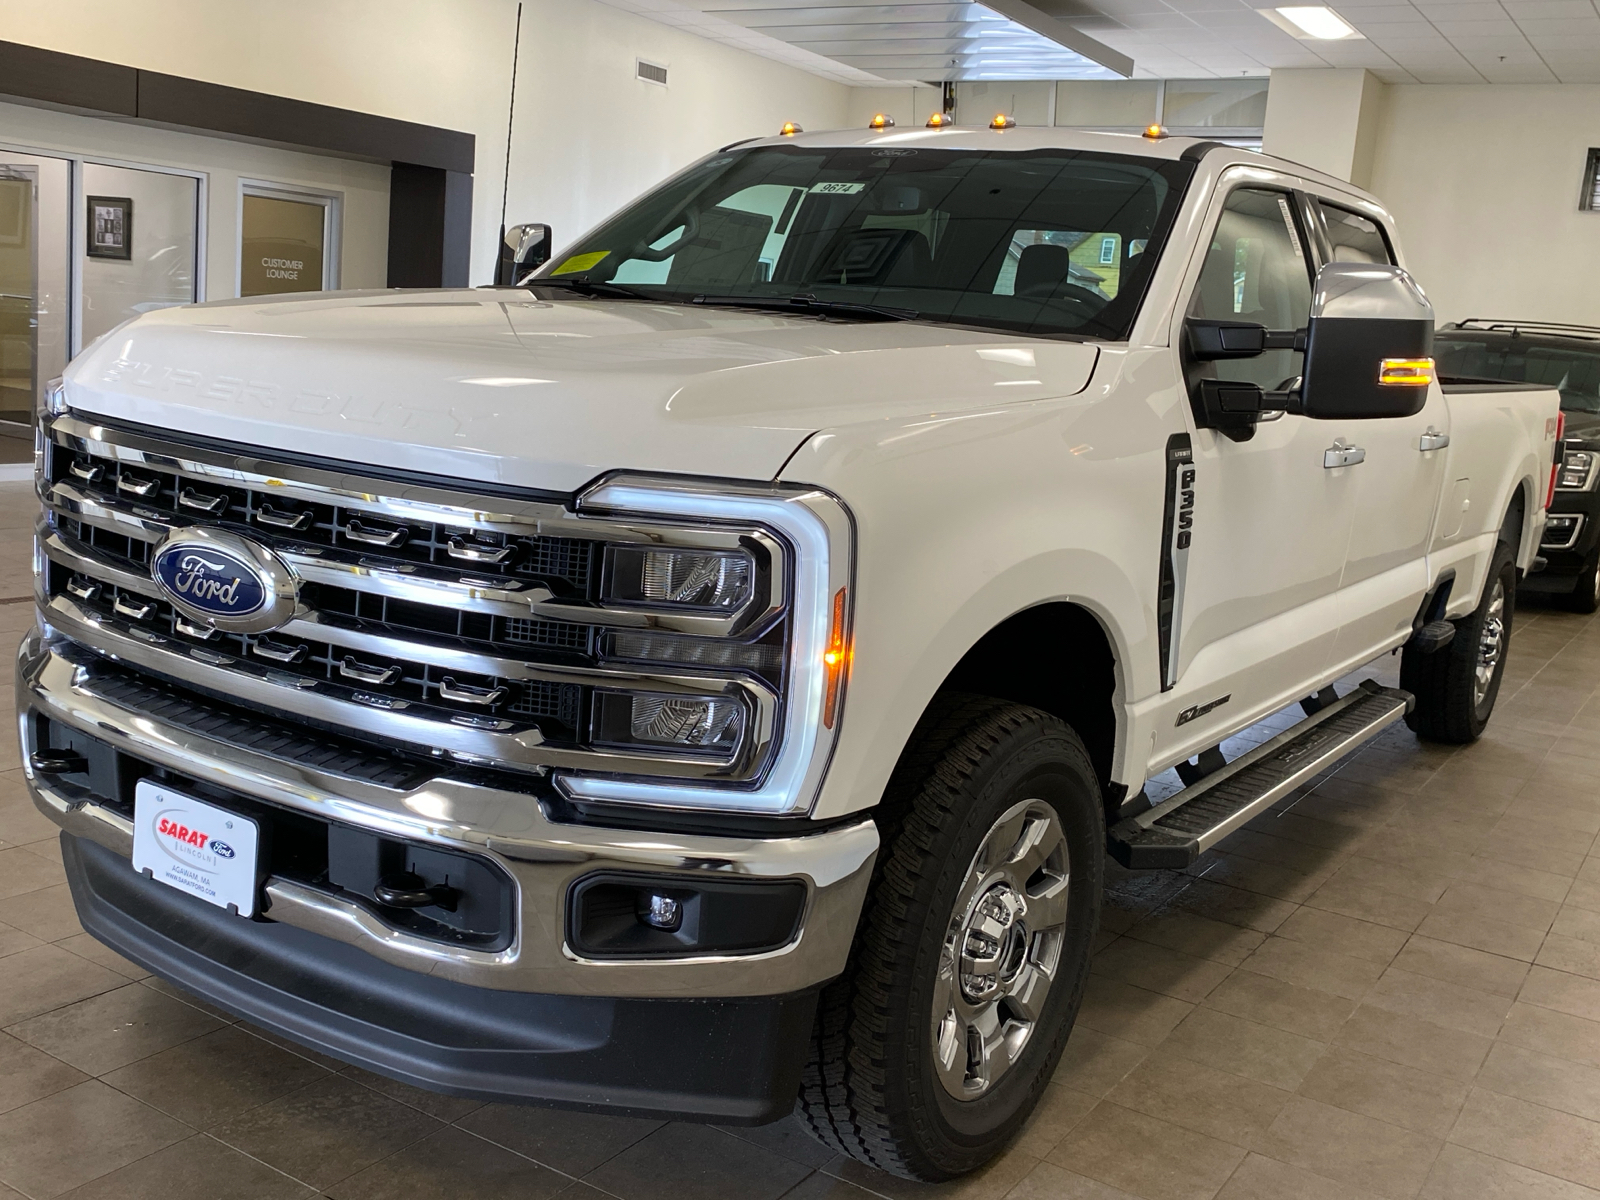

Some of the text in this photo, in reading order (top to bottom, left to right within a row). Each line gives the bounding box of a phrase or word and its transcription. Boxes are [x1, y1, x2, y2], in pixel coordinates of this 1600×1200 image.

[820, 183, 853, 193] 9674
[261, 257, 304, 270] CUSTOMER
[266, 269, 298, 280] LOUNGE
[100, 358, 499, 437] SUPER DUTY
[174, 555, 241, 606] Ford
[158, 817, 209, 849] SARAT
[180, 843, 212, 863] LINCOLN
[212, 841, 232, 857] Ford
[165, 870, 217, 898] WWW.SARATFORD.COM
[200, 877, 211, 886] MA
